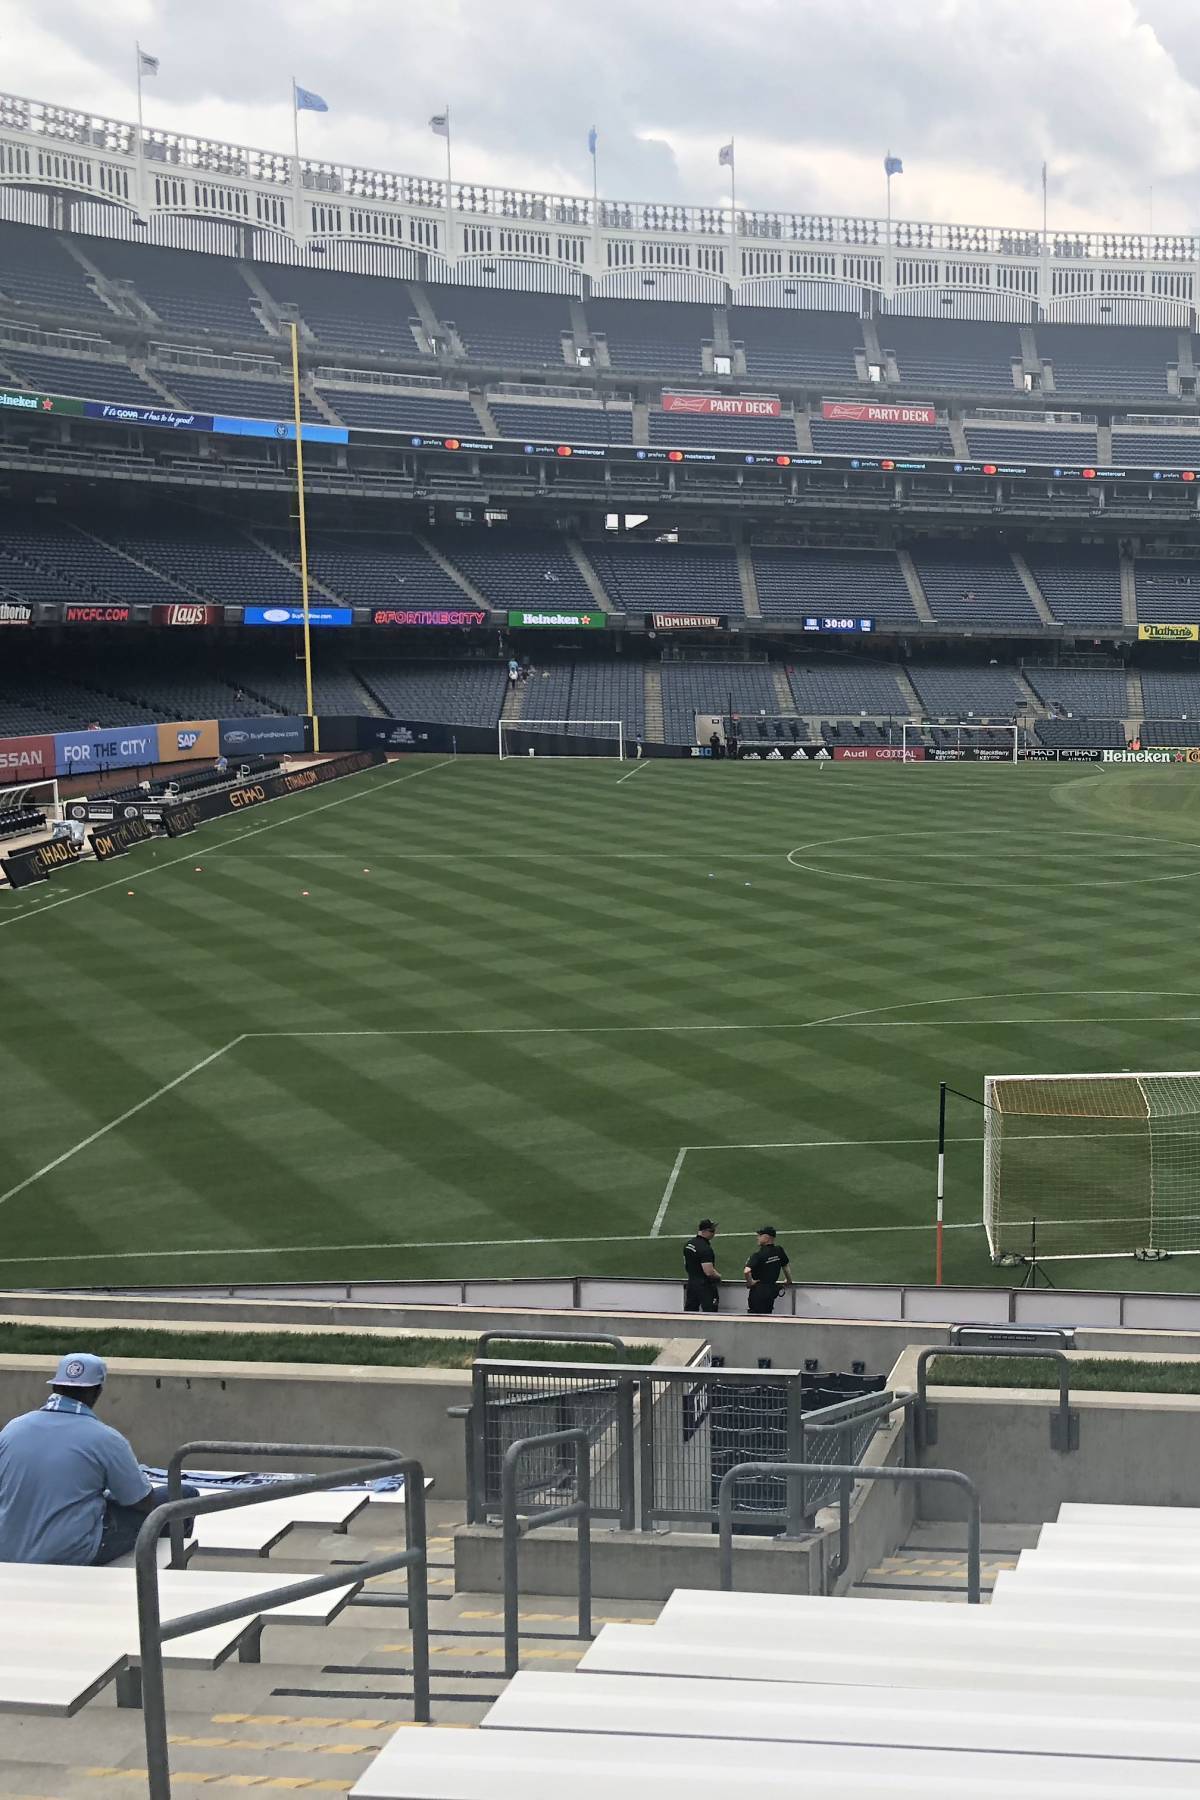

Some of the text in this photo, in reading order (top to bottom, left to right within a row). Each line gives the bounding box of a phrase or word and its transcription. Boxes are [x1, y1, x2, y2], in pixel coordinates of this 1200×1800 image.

[117, 410, 138, 418] GOYA
[711, 400, 743, 413] PARTY
[746, 401, 773, 415] DECK
[869, 408, 899, 421] PARTY
[902, 409, 929, 422] DECK
[0, 603, 31, 620] thority
[67, 608, 129, 621] NYCFC.COM
[374, 611, 485, 625] #FORTHECITY
[523, 614, 579, 625] Heineken
[656, 616, 719, 627] ADMIRATION
[824, 619, 854, 628] 30:00
[1144, 626, 1192, 636] Nathan's
[177, 733, 197, 748] SAP
[250, 731, 299, 740] BuyFordNow.com
[64, 739, 146, 762] FOR THE CITY
[843, 750, 868, 758] Audi
[980, 749, 1010, 757] BlackBerry
[1103, 750, 1171, 763] Heineken
[0, 750, 43, 768] SSAN
[229, 785, 265, 807] ETIHAD
[95, 837, 115, 855] OM
